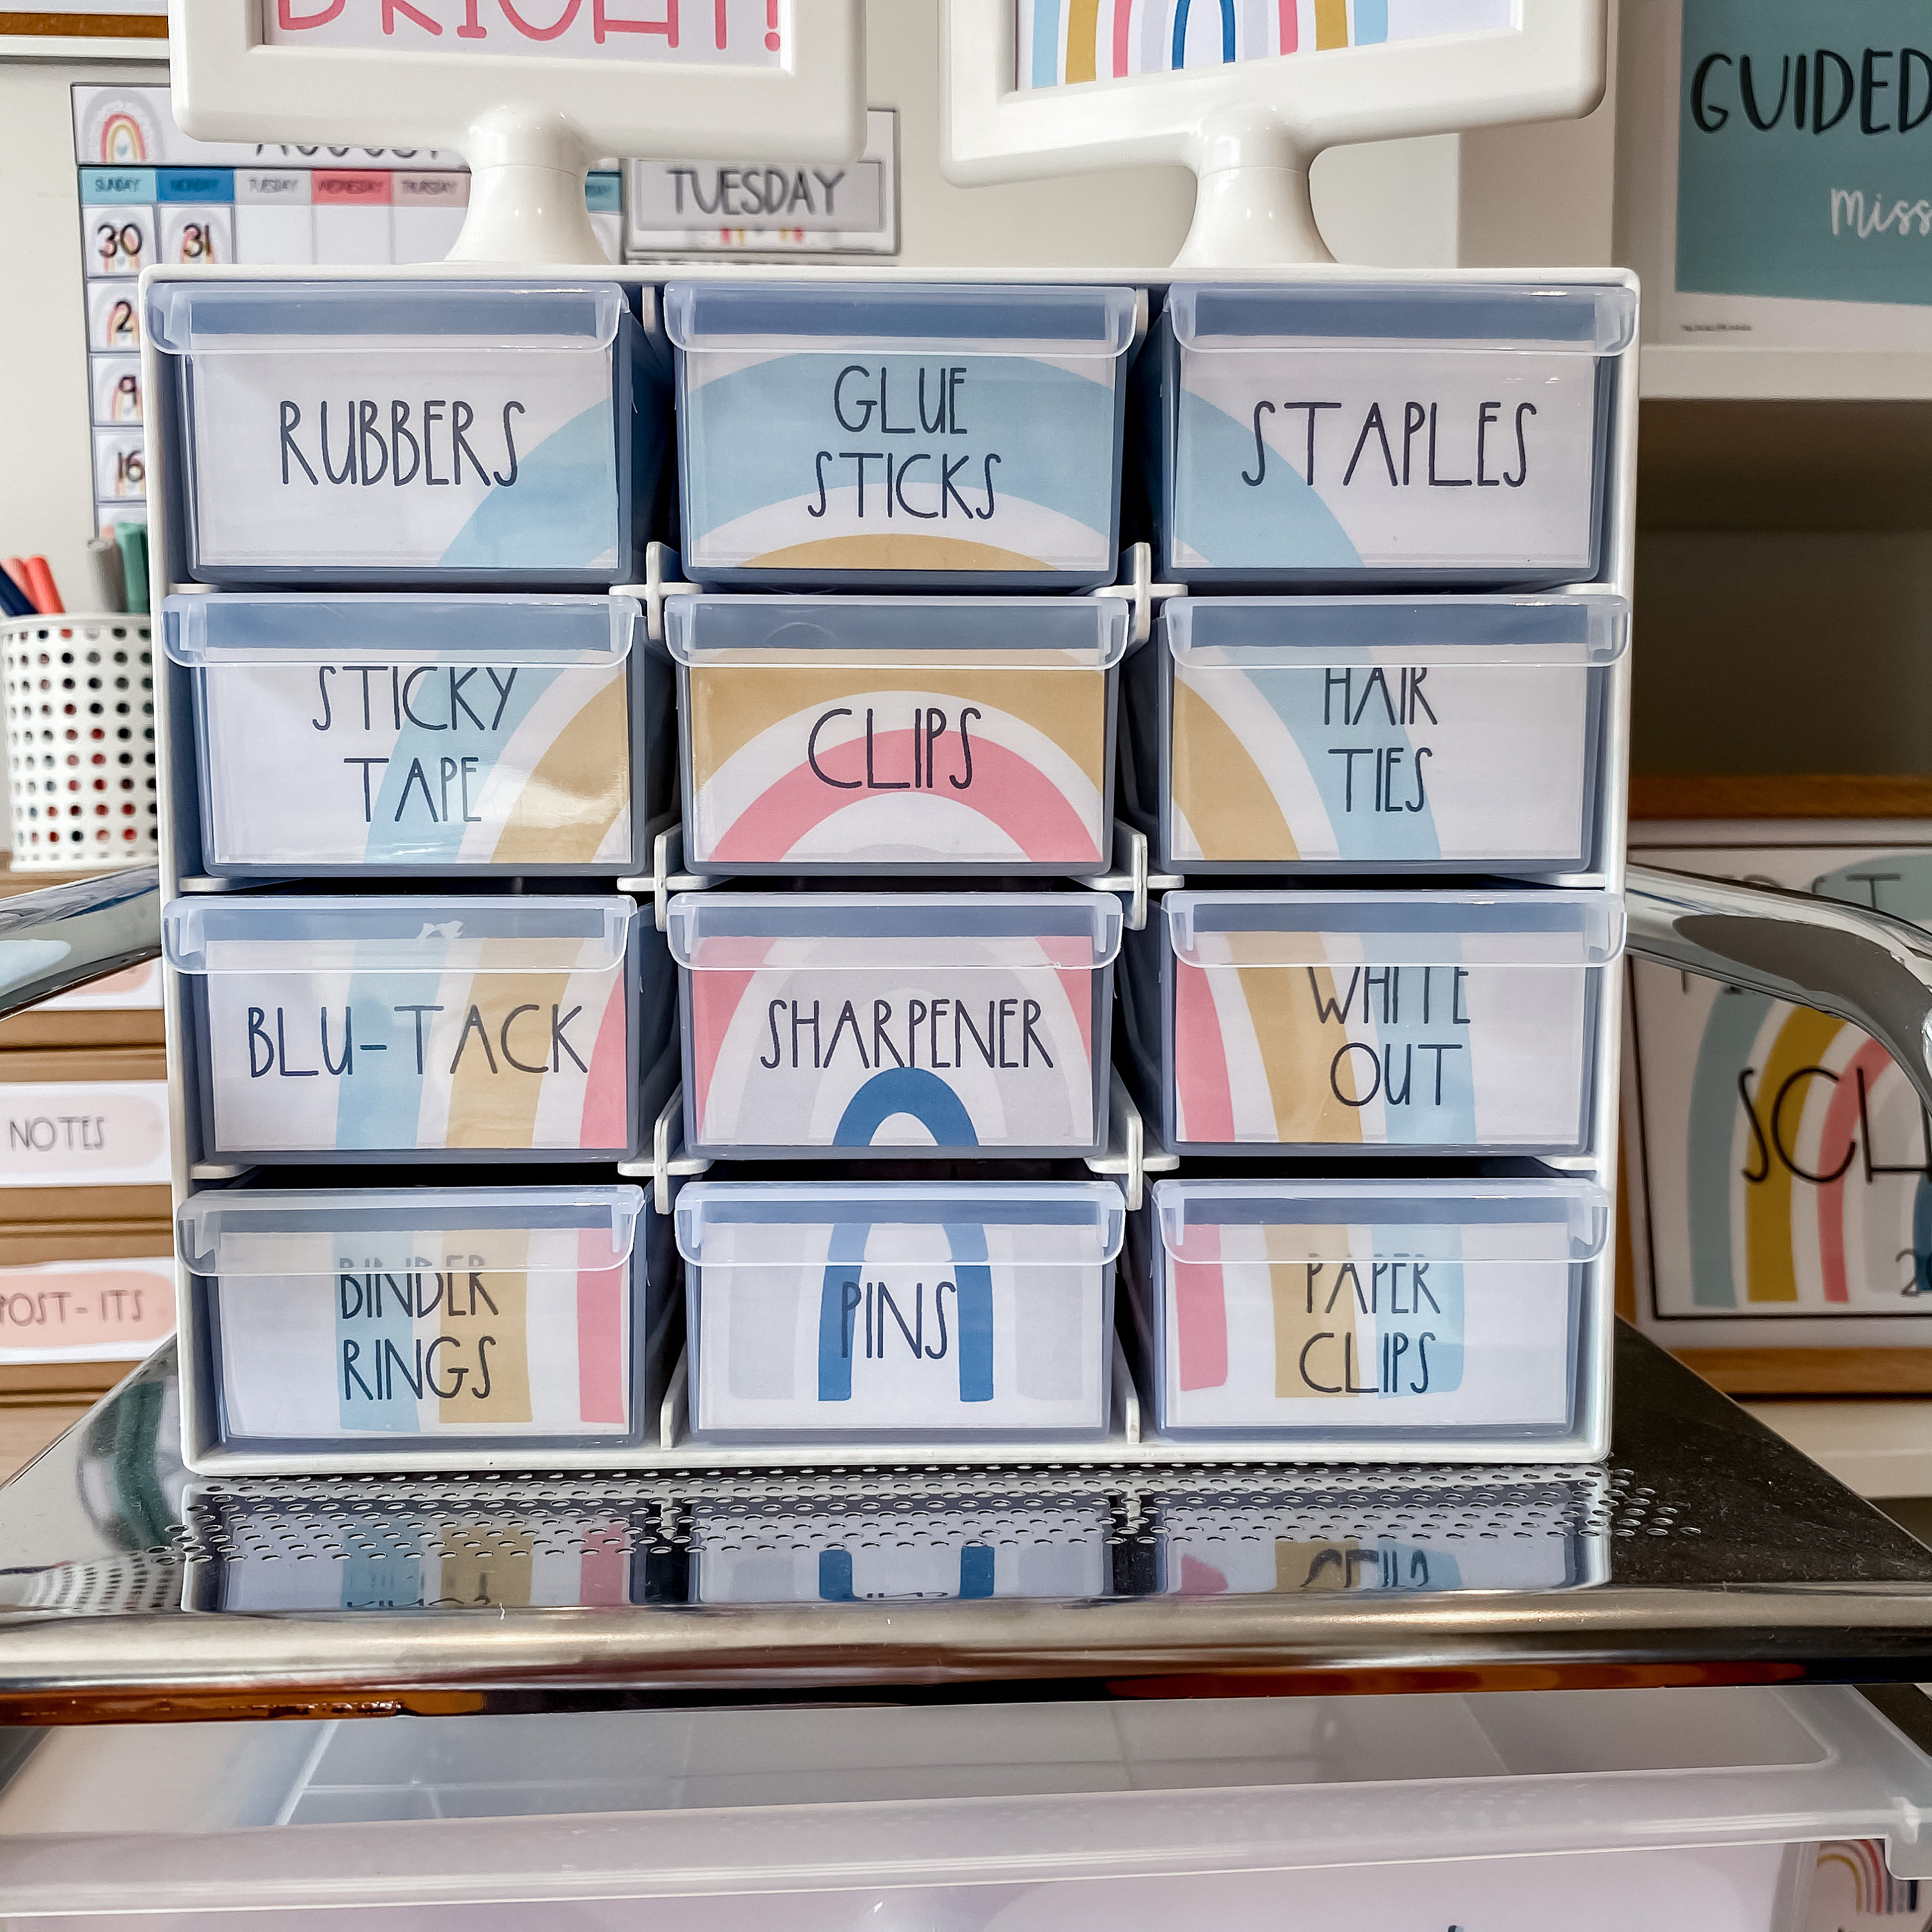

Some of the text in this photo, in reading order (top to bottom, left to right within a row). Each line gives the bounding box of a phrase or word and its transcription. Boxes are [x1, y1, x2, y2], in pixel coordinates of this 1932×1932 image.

[1690, 48, 1932, 135] GUIDED
[666, 167, 846, 216] TUESDAY
[1831, 189, 1932, 238] Miss
[97, 223, 143, 258] 30
[184, 223, 212, 258] 31
[114, 299, 133, 332] 2
[118, 375, 138, 406] 9
[834, 365, 967, 435] GLUE
[117, 451, 145, 482] 16
[280, 400, 525, 487] RUBBERS
[1241, 401, 1537, 488] STAPLES
[808, 451, 1001, 520] STICKS
[312, 666, 518, 731] STICKY
[1324, 667, 1438, 726] HAIR
[808, 707, 981, 790] CLIPS
[1327, 747, 1433, 813] TIES
[344, 757, 482, 822] TAPE
[1307, 967, 1471, 1025] WHITE
[248, 1004, 588, 1078] BLU-TACK
[760, 999, 1054, 1069] SHARPENER
[1330, 1042, 1463, 1107] OUT
[9, 1116, 105, 1151] NOTES
[339, 1255, 499, 1320] BINDER
[1305, 1253, 1441, 1314] PAPER
[841, 1281, 956, 1359] PINS
[343, 1336, 497, 1401] RINGS
[1300, 1332, 1436, 1394] CLIPS
